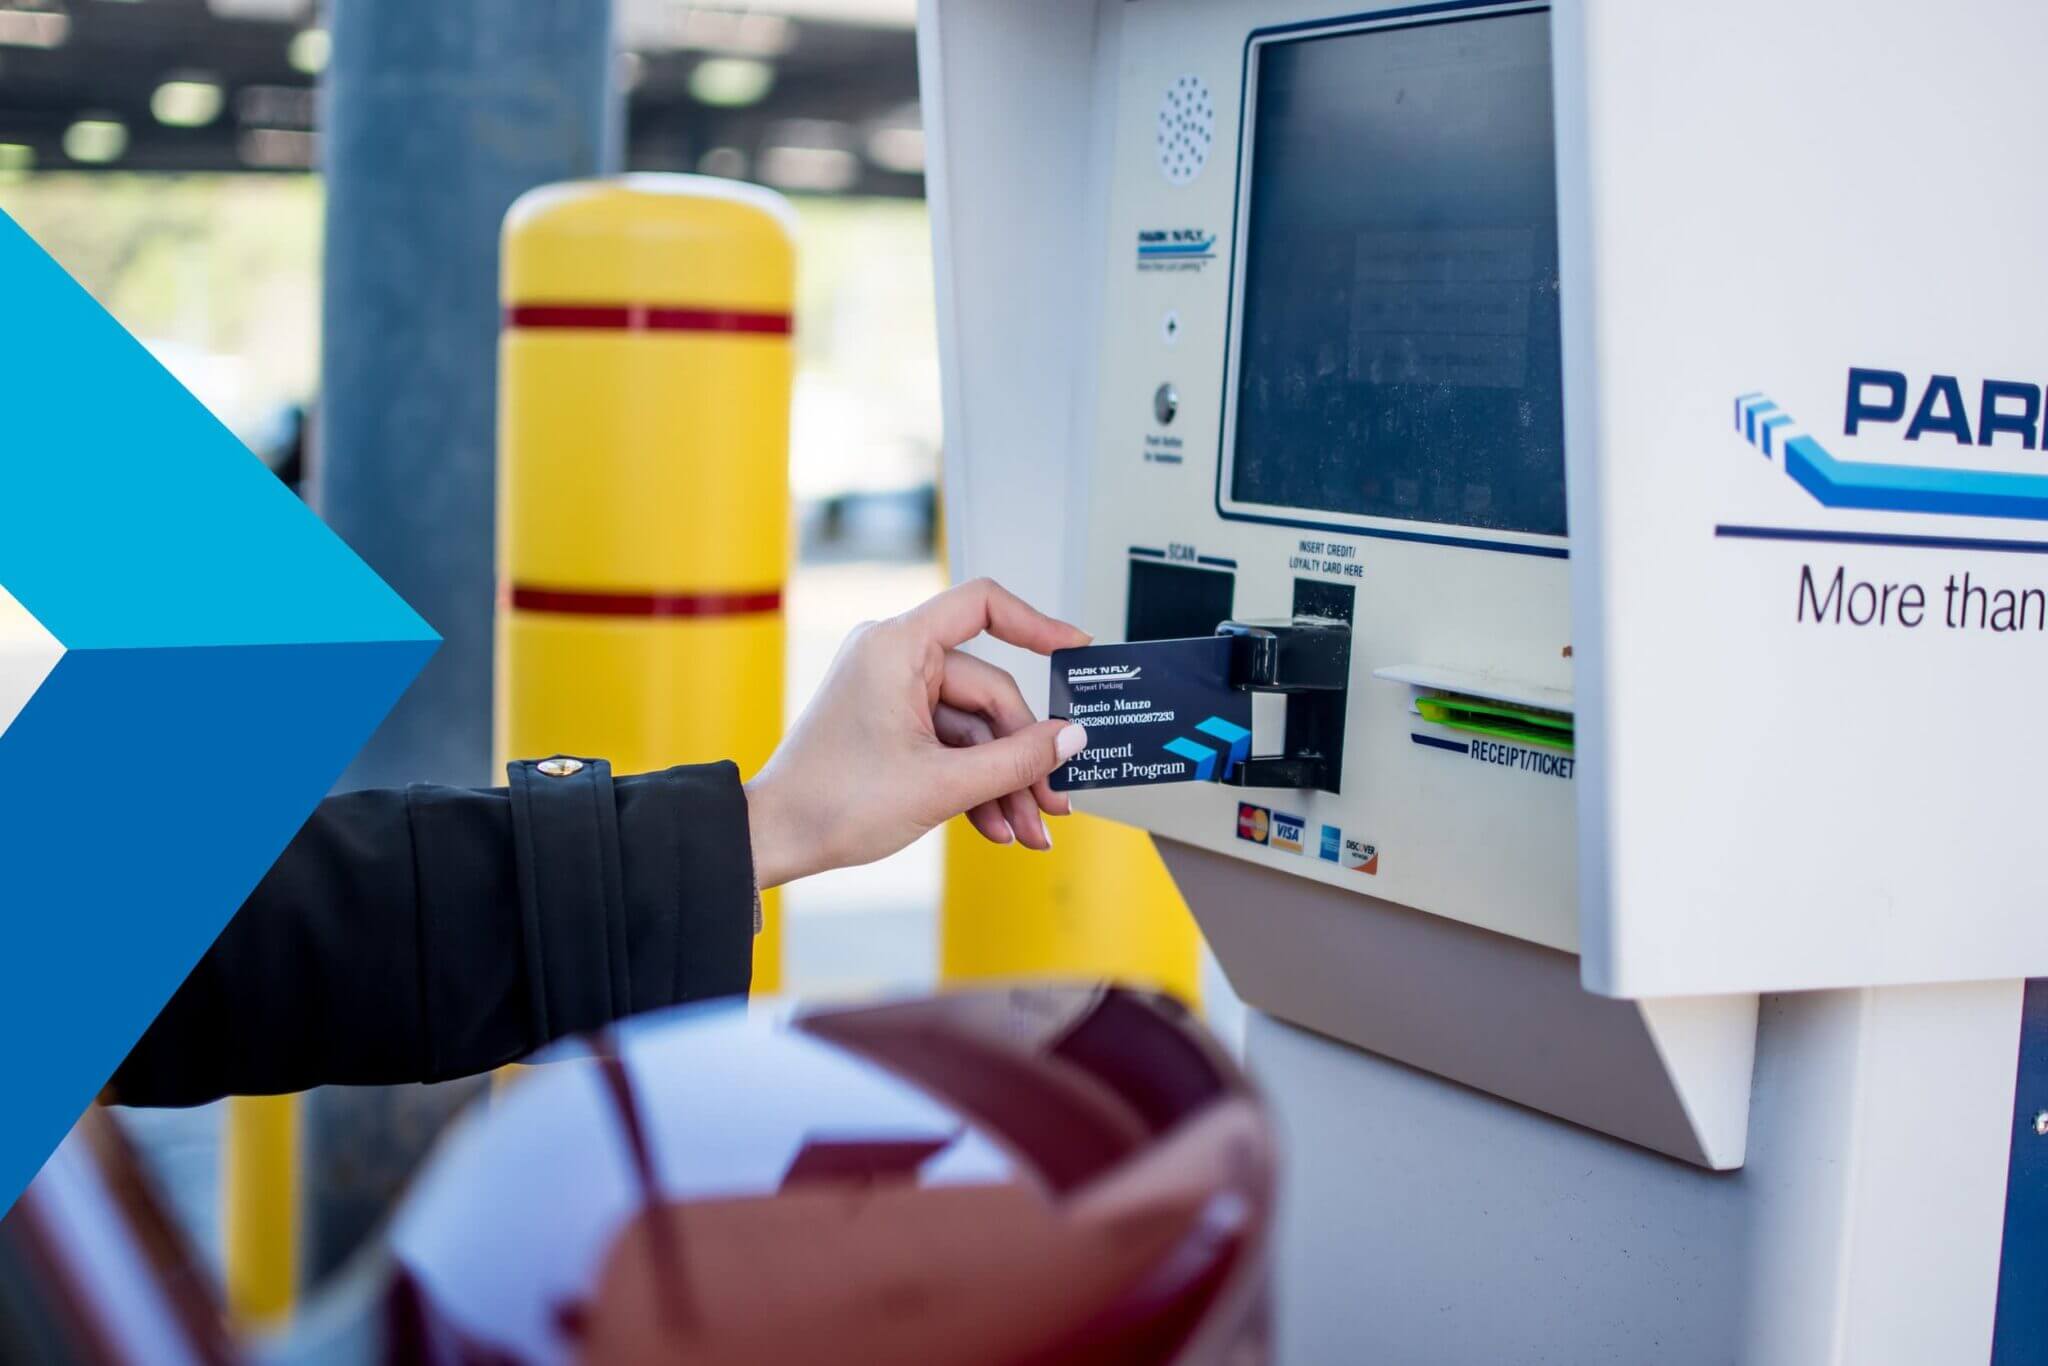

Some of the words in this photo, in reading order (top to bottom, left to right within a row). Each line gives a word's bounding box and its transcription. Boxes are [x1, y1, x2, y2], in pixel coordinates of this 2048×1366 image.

[1844, 366, 2048, 451] PAR
[1167, 542, 1196, 562] SCAN
[1299, 541, 1325, 554] INSERT
[1327, 543, 1356, 558] CREDIT/
[1289, 555, 1320, 571] LOYALTY
[1322, 560, 1342, 574] CARD
[1344, 563, 1364, 577] HERE
[1797, 564, 1926, 628] More
[1944, 571, 2046, 632] than
[1068, 667, 1098, 676] PARK
[1075, 683, 1097, 693] Airport
[1099, 682, 1124, 690] Parking
[1068, 700, 1111, 716] Ignacio
[1114, 699, 1151, 711] Manzo
[1068, 743, 1134, 763] requent
[1471, 739, 1575, 780] RECEIPT/TICKET
[1067, 765, 1117, 782] Parker
[1122, 761, 1186, 778] Program
[1277, 823, 1299, 842] VISA
[1346, 840, 1375, 855] DISCOVER
